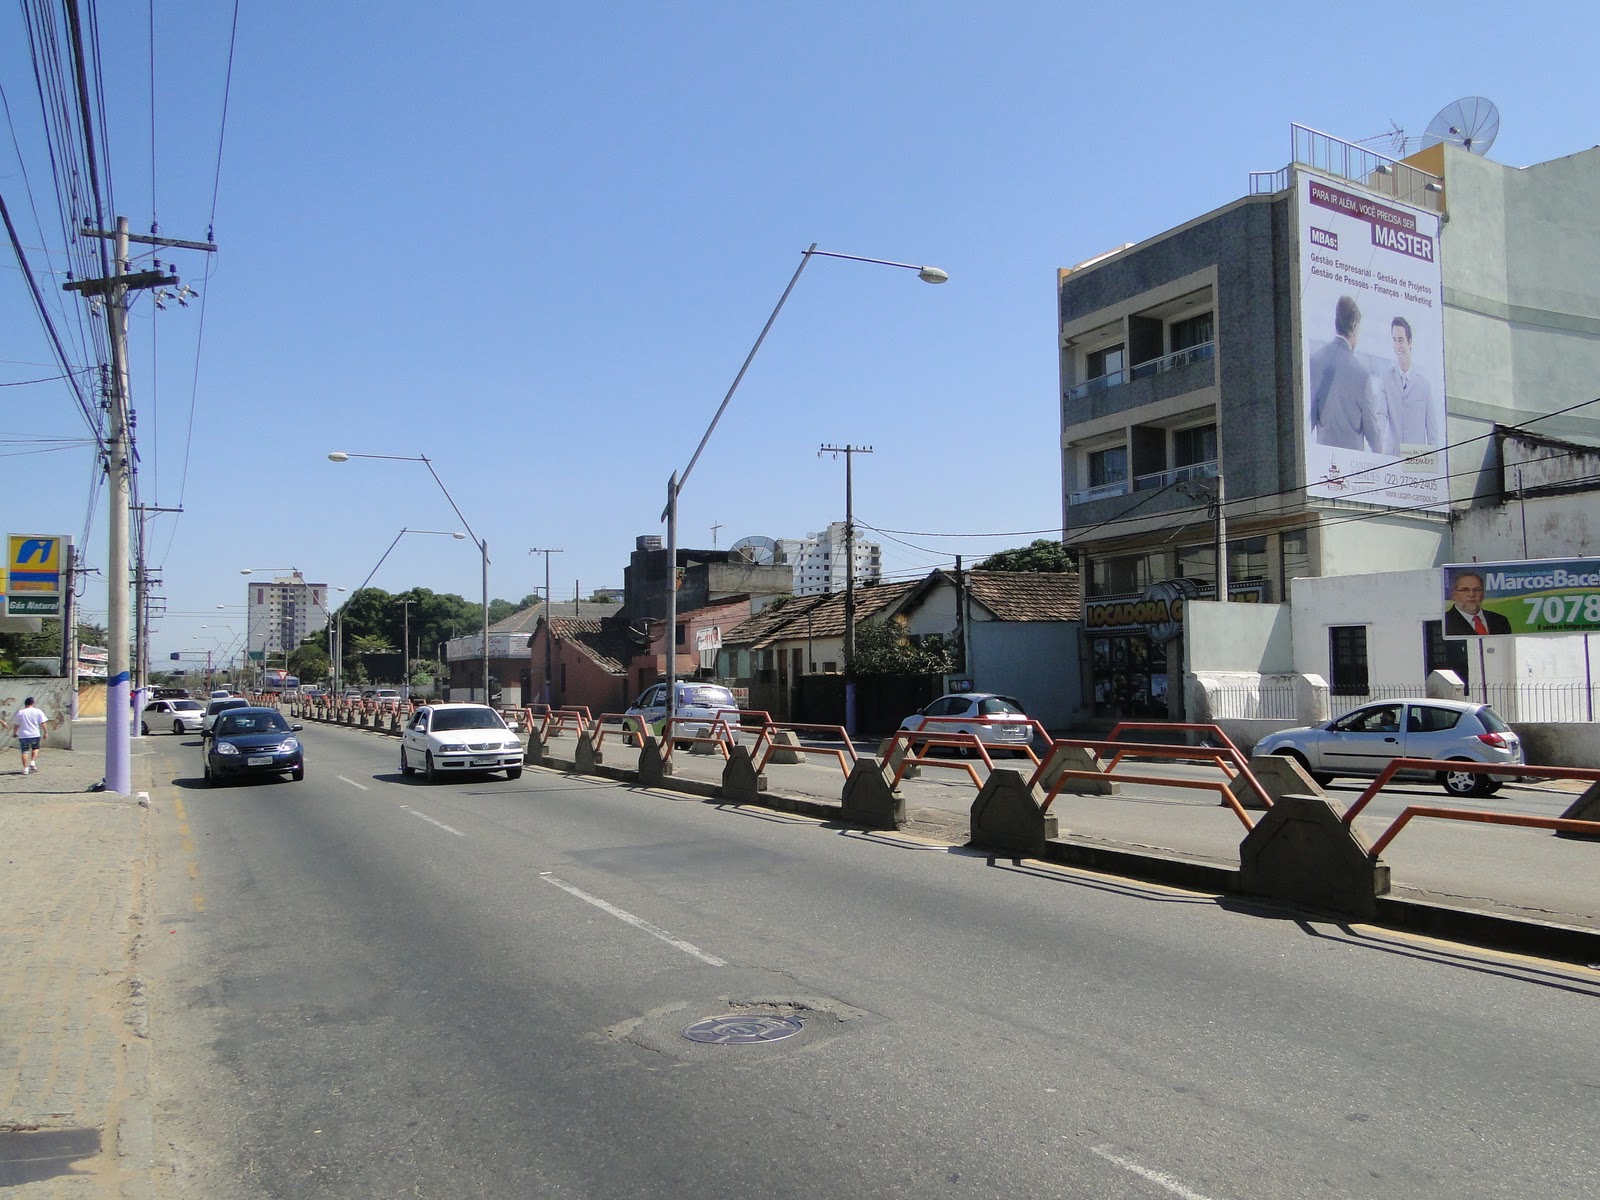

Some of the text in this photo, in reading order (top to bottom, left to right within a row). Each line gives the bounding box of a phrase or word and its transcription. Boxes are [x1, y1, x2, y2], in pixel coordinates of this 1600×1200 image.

[1312, 188, 1415, 230] PARA IR ALÉM, VOCÊ PRECISA SER
[1311, 229, 1337, 249] MBAs:
[1375, 224, 1432, 260] MASTER
[1310, 252, 1333, 267] Gestão
[1335, 259, 1371, 278] Empresarial
[1377, 271, 1398, 285] Gestão
[1399, 278, 1406, 288] de
[1407, 280, 1432, 295] Projetos
[1311, 266, 1333, 280] Gestão
[1334, 273, 1343, 283] de
[1344, 275, 1369, 290] Pessoas
[1374, 283, 1400, 299] Finanças
[1404, 291, 1432, 308] Marketing
[10, 601, 59, 610] Gás Natural
[1087, 599, 1170, 627] LOCADORA
[1523, 594, 1600, 624] 7078
[477, 647, 507, 655] Vdro
